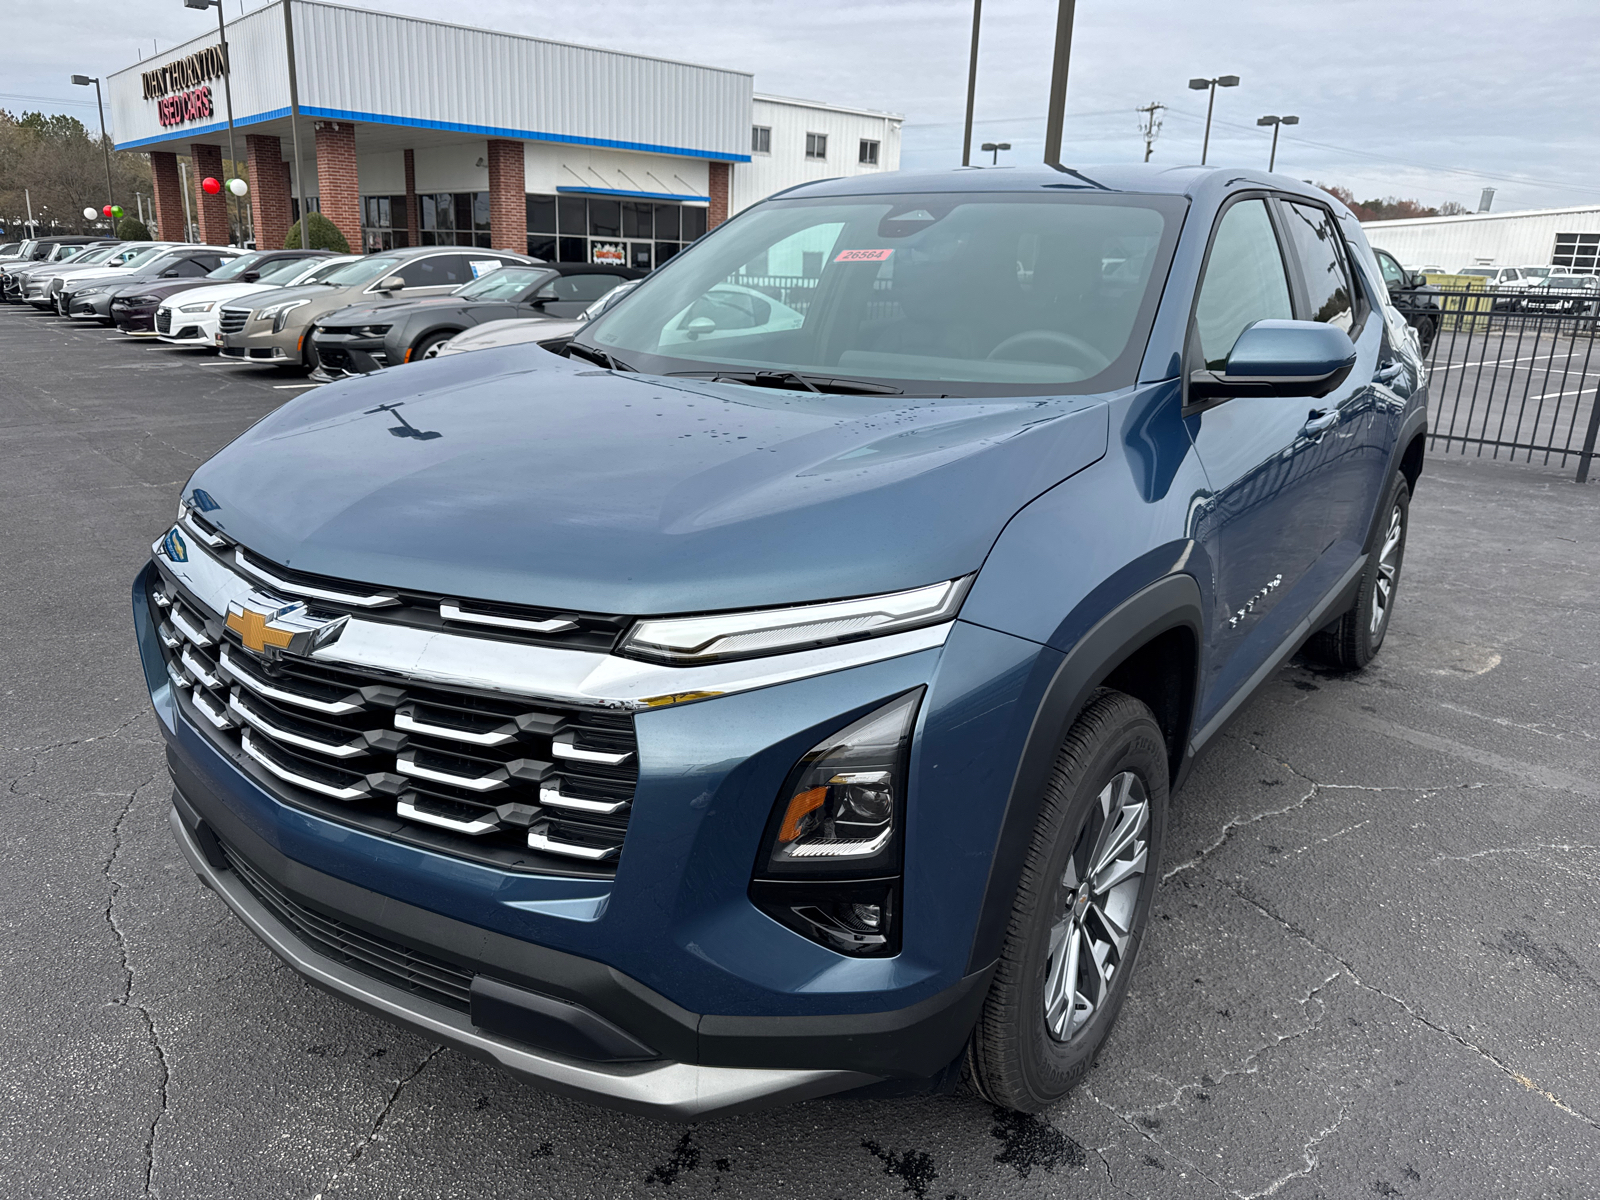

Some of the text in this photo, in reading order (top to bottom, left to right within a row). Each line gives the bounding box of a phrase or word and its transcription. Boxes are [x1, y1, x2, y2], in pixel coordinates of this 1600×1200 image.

[141, 42, 230, 100] JOHN THORNTON
[157, 86, 213, 127] USED CARS
[842, 250, 885, 260] 26564
